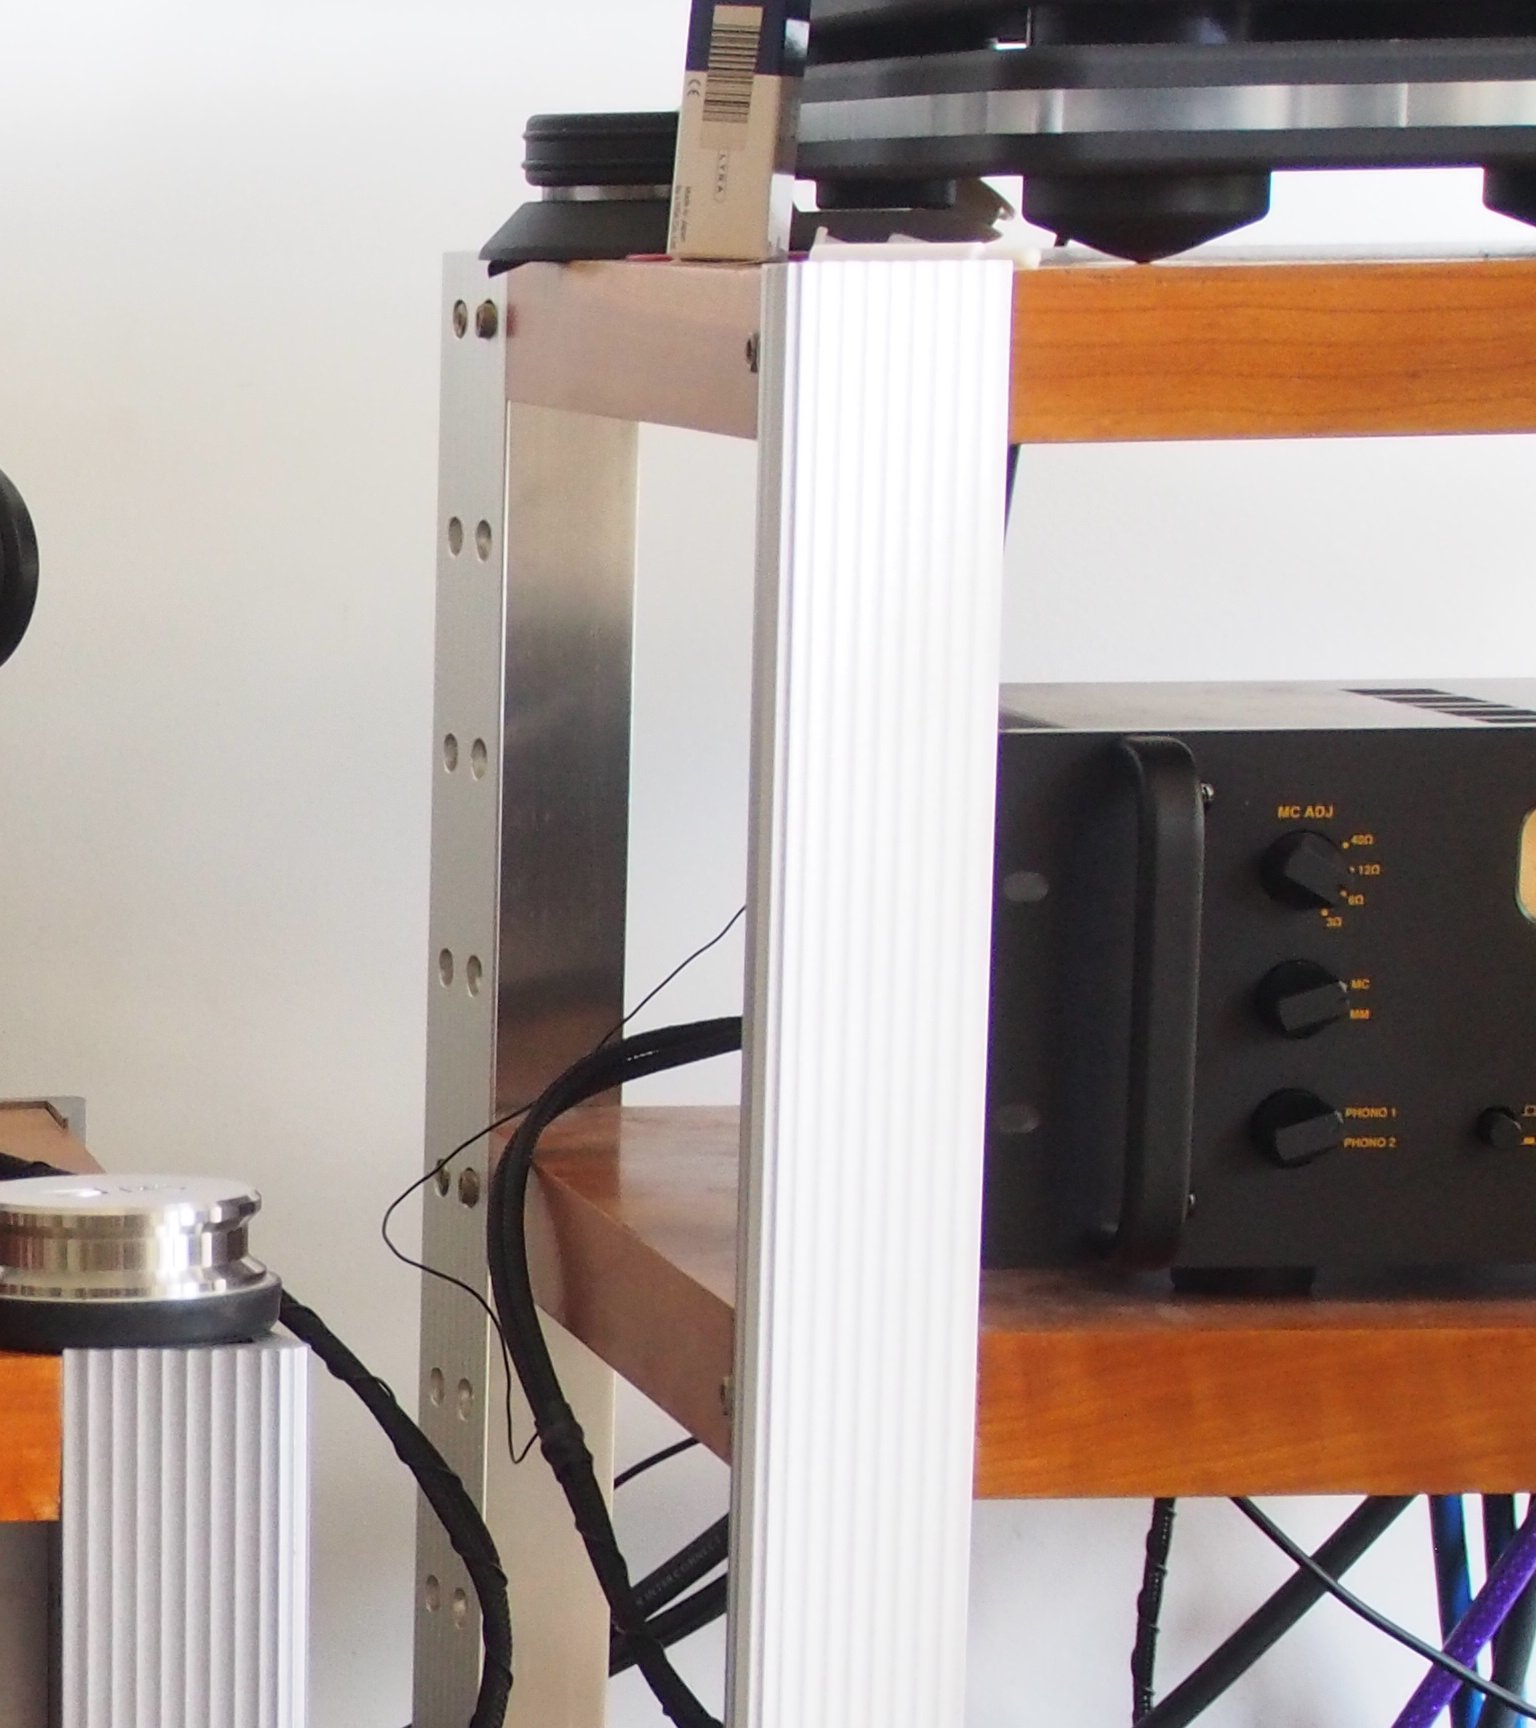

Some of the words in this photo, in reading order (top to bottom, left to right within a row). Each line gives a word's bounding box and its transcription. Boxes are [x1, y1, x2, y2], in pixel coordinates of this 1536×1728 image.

[1278, 806, 1300, 818] MC
[1305, 805, 1333, 818] ADJ
[1351, 979, 1370, 989] MC
[1345, 1107, 1387, 1118] PHONO
[1343, 1137, 1386, 1148] PHONO
[1388, 1137, 1396, 1148] 2
